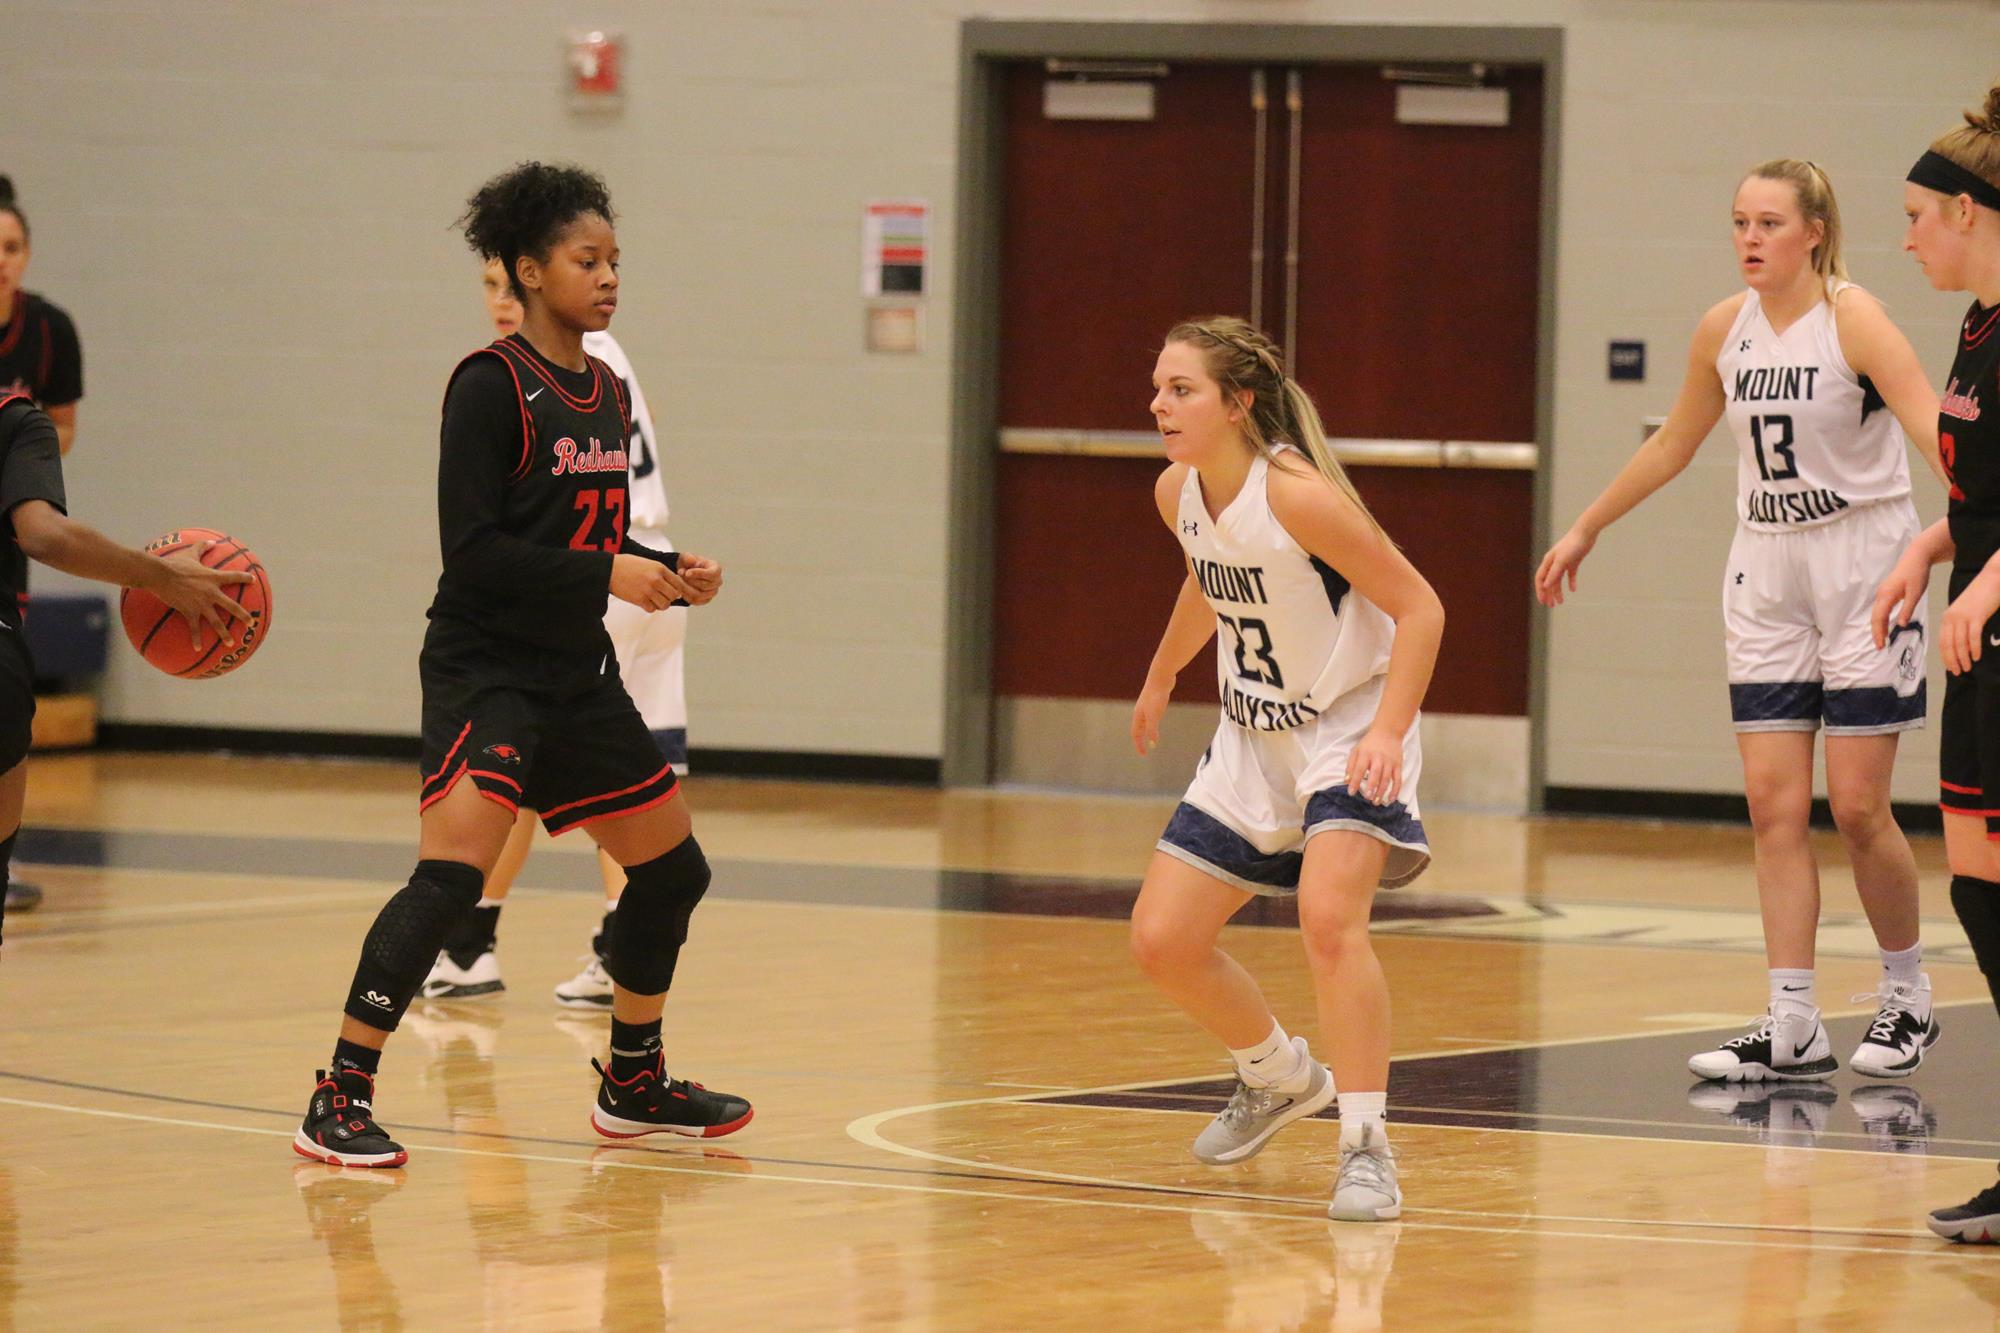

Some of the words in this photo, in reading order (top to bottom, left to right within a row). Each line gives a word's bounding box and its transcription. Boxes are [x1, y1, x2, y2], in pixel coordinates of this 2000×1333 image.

[1733, 367, 1819, 402] MOUNT
[552, 437, 628, 475] Redhaw
[1751, 415, 1799, 481] 13
[569, 487, 625, 554] 23
[1192, 557, 1269, 604] MOUNT
[1217, 611, 1284, 690] 23
